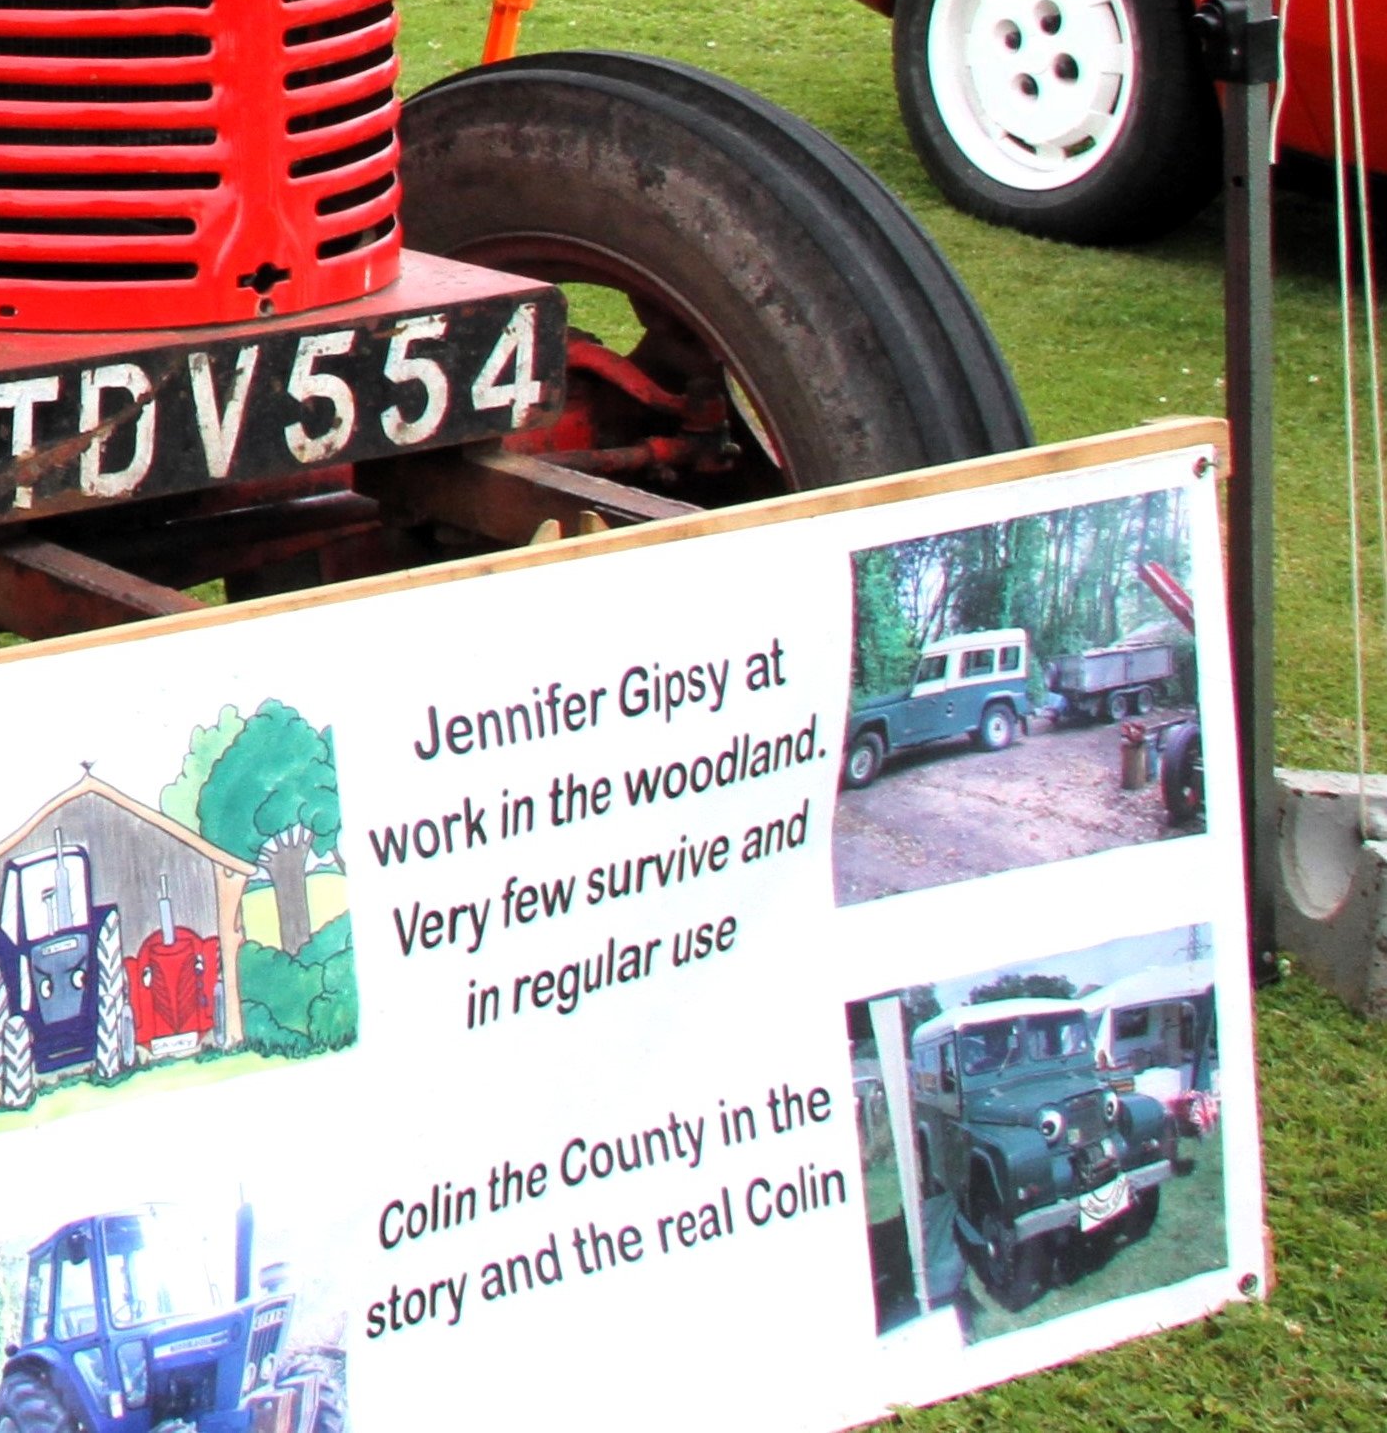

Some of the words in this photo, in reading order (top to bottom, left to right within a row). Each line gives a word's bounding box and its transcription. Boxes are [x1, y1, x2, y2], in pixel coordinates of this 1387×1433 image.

[414, 682, 607, 761] Jennifer
[619, 659, 730, 723] Gipsy
[745, 637, 787, 692] at
[368, 797, 488, 868] work
[501, 789, 534, 839] in
[549, 772, 612, 827] the
[624, 712, 827, 807] woodland.
[393, 897, 491, 957] Very
[502, 875, 576, 928] few
[586, 834, 730, 904] survive
[741, 798, 810, 864] and
[467, 979, 500, 1029] in
[512, 936, 662, 1015] regular
[672, 914, 737, 967] use
[378, 1182, 477, 1251] Colin
[488, 1160, 548, 1213] the
[559, 1112, 705, 1188] County
[719, 1099, 758, 1147] in
[766, 1082, 832, 1135] the
[366, 1272, 468, 1339] story
[479, 1232, 564, 1301] and
[572, 1221, 646, 1275] the
[656, 1187, 735, 1255] real
[745, 1162, 847, 1228] Colin
